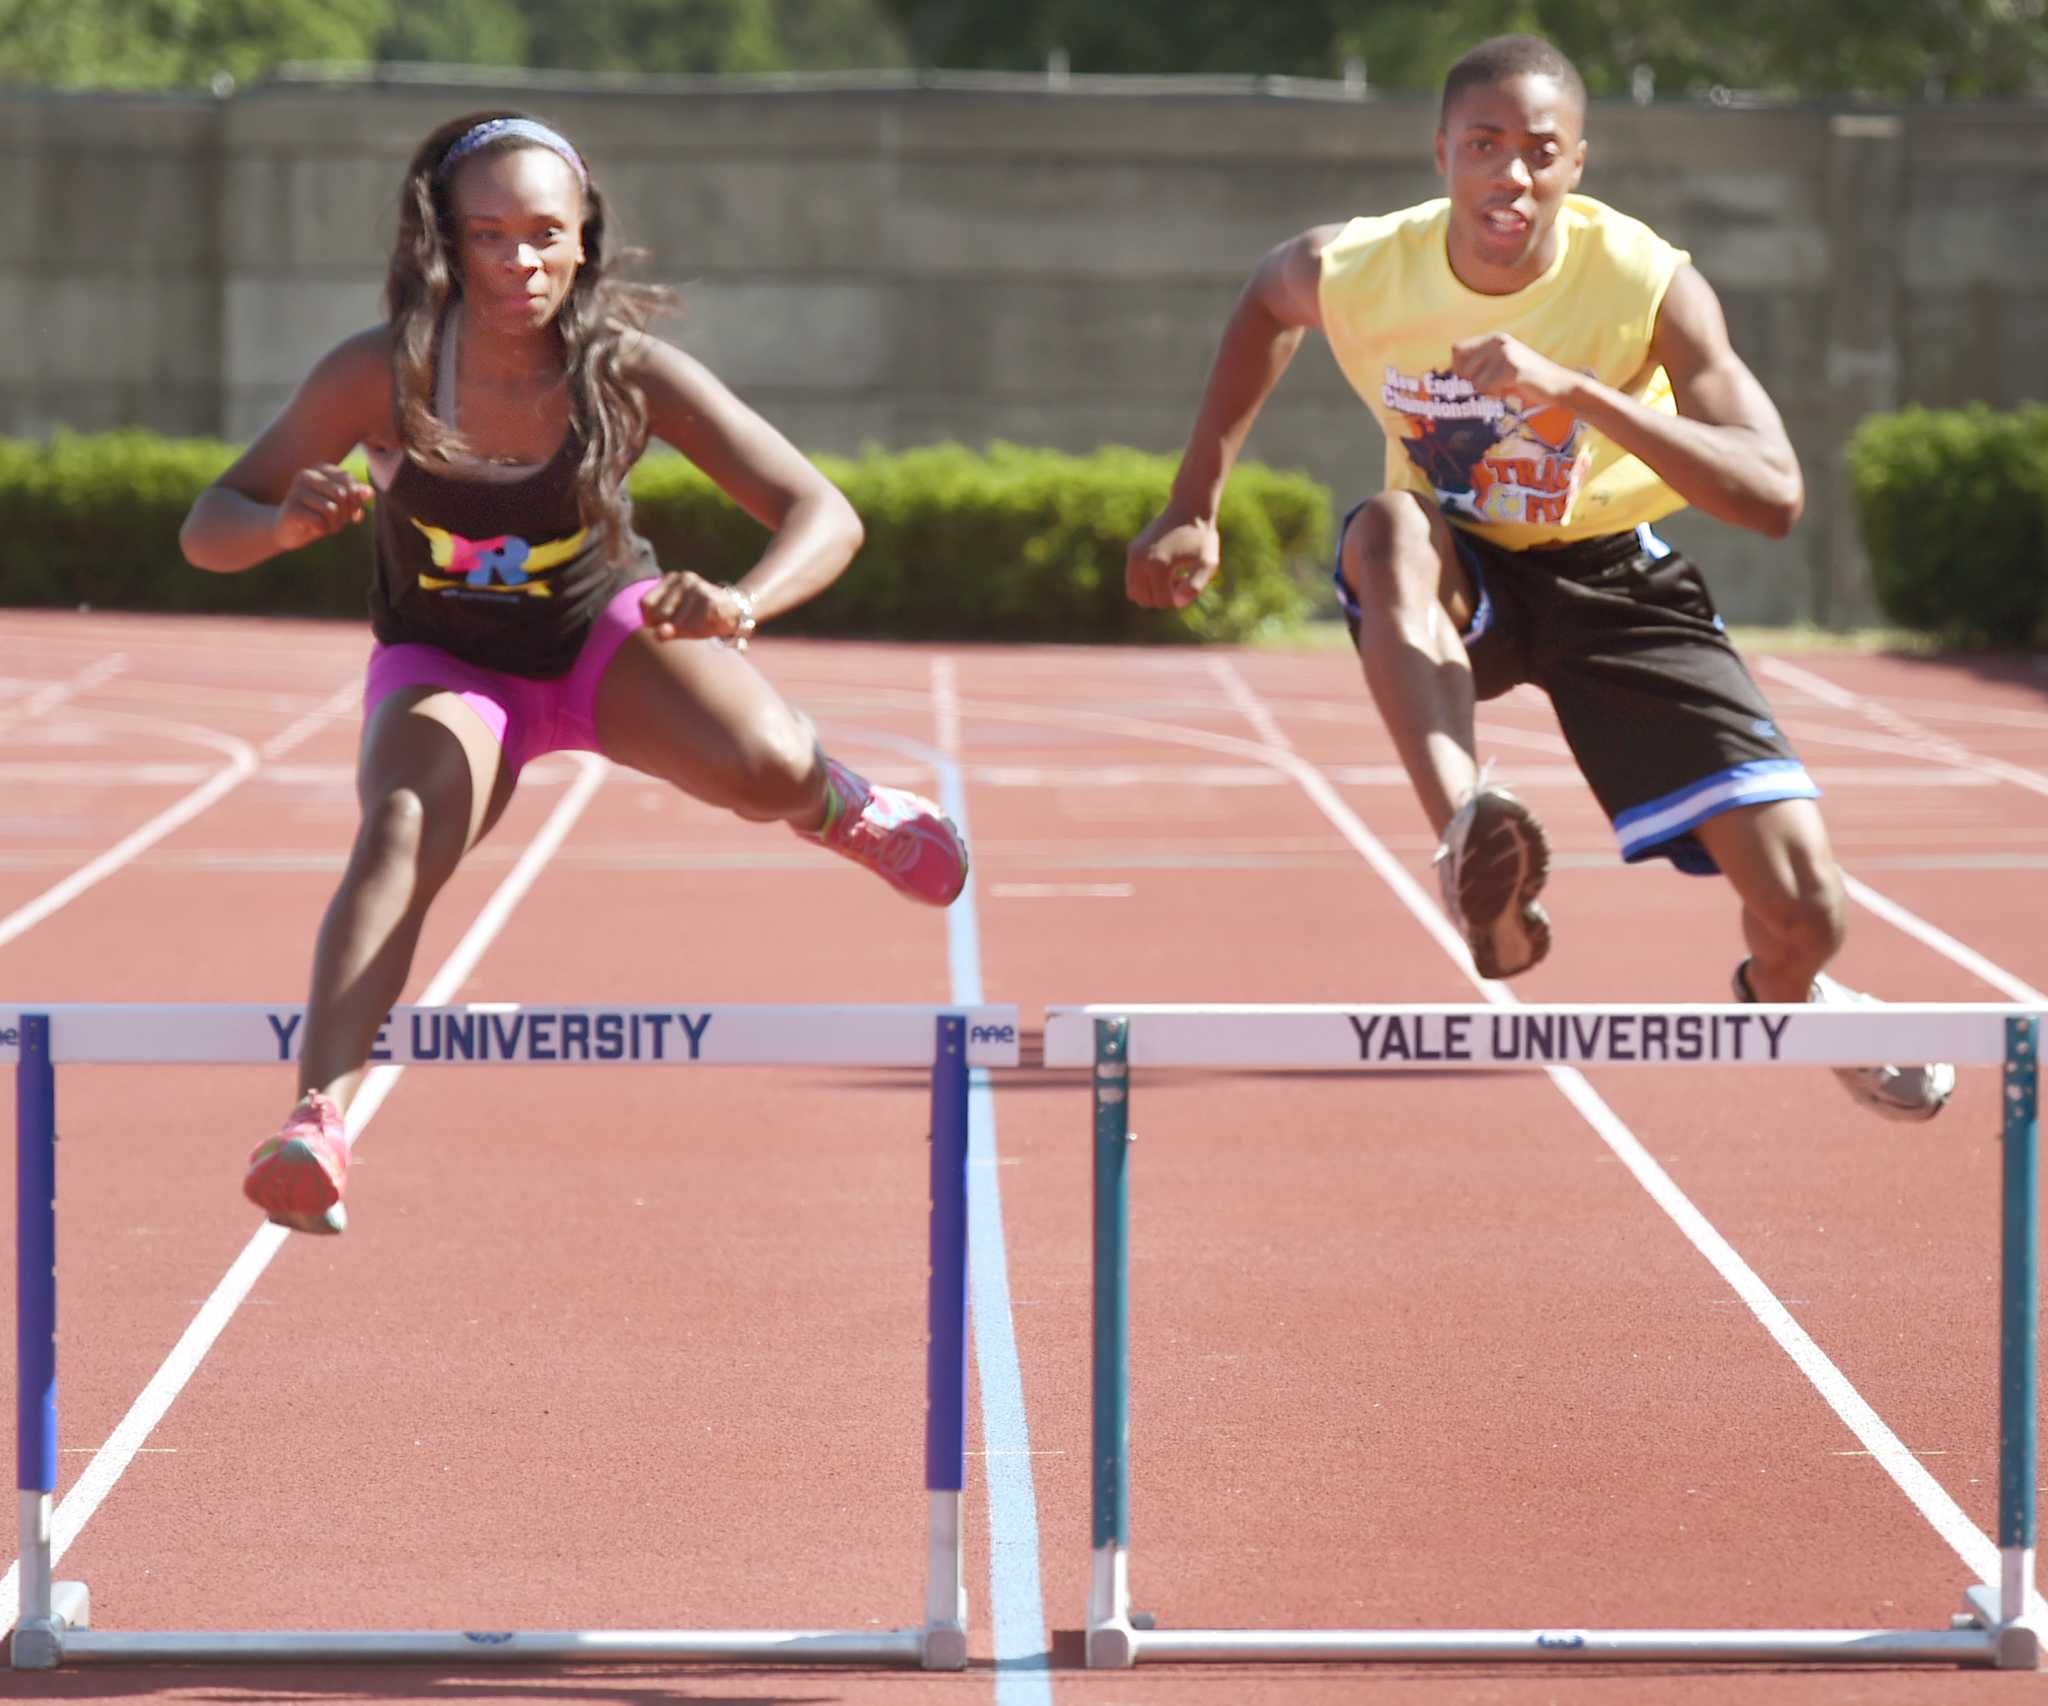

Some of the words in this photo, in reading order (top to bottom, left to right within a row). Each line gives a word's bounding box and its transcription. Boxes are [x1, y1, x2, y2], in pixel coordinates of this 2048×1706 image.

[267, 1013, 392, 1061] YE
[410, 1013, 713, 1061] UNIVERSITY
[1348, 1014, 1472, 1061] YALE
[1491, 1014, 1791, 1061] UNIVERSITY
